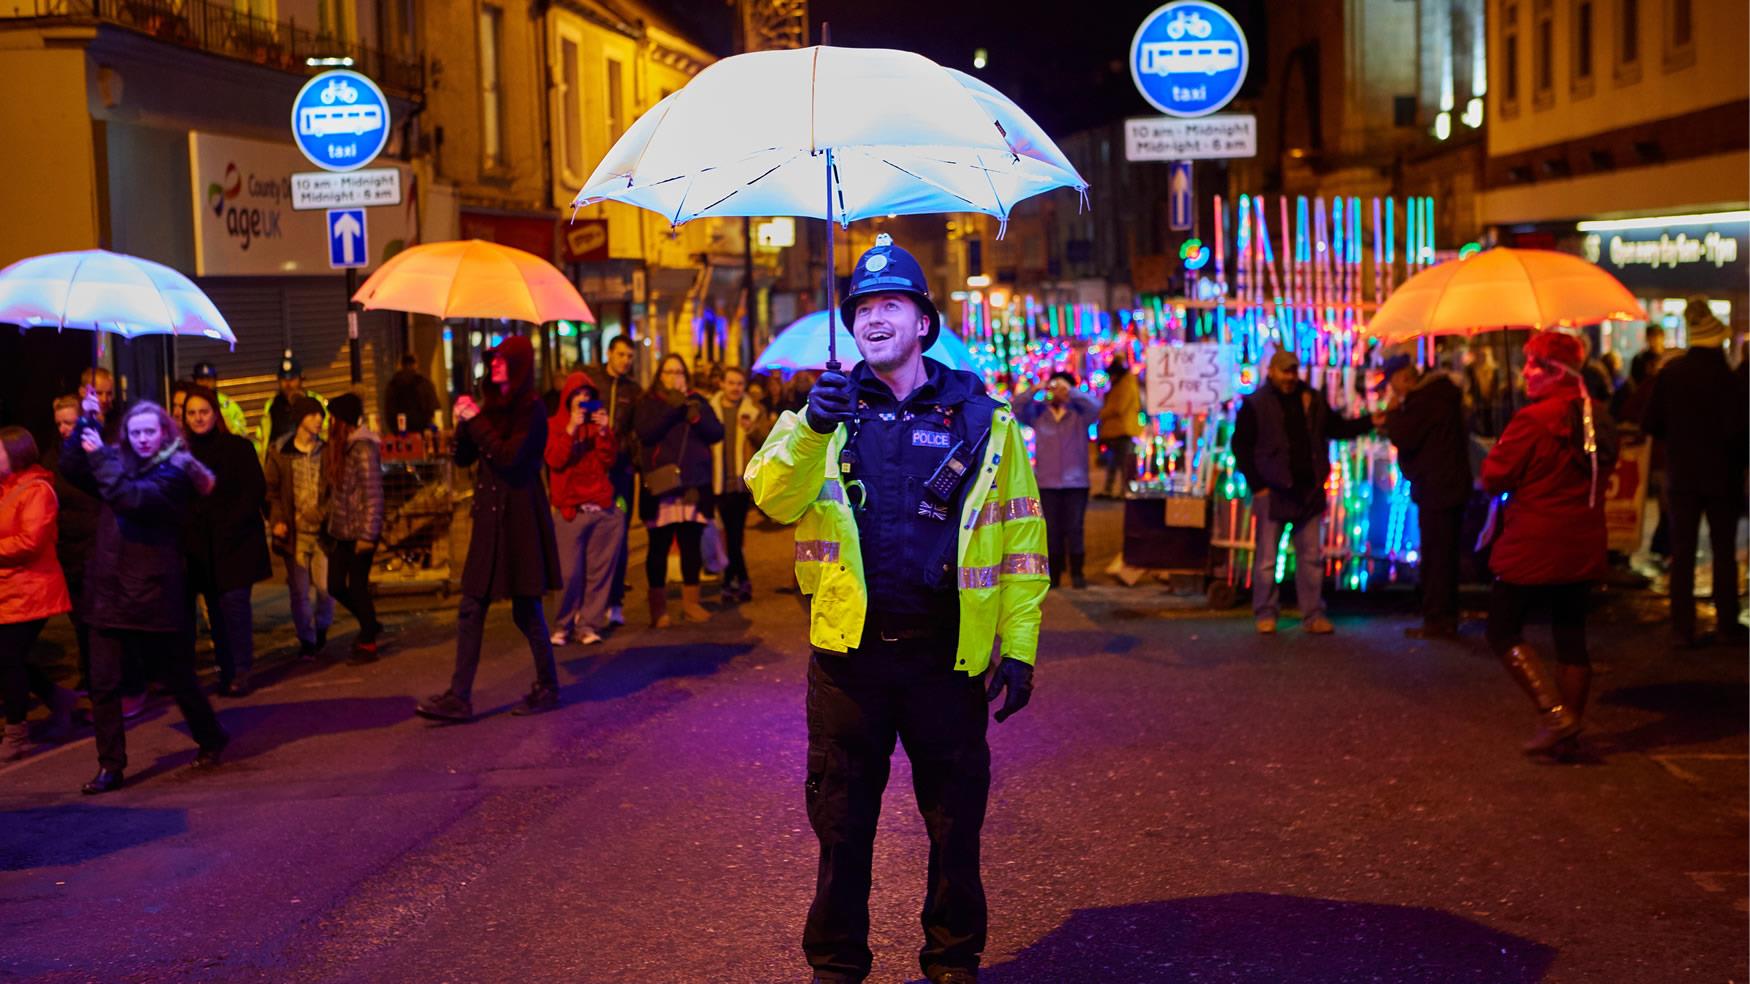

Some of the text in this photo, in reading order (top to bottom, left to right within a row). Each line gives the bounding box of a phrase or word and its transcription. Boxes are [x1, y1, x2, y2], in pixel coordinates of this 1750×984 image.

[1172, 85, 1207, 102] taxi
[1132, 127, 1149, 138] 10
[1153, 128, 1174, 137] am
[1185, 123, 1250, 137] Midnight
[327, 143, 357, 159] taxi
[1137, 140, 1200, 153] Midnight
[1213, 139, 1221, 150] 6
[1226, 140, 1247, 149] am
[248, 174, 281, 204] County
[297, 180, 310, 190] 10
[314, 180, 331, 189] am
[341, 175, 395, 187] Midnight
[301, 190, 354, 202] Midnight
[363, 189, 371, 199] 6
[375, 190, 392, 199] am
[1156, 351, 1175, 378] 1
[1200, 349, 1219, 378] 3
[1157, 380, 1176, 408] 2
[1202, 379, 1220, 406] 5
[913, 432, 950, 446] POLICE
